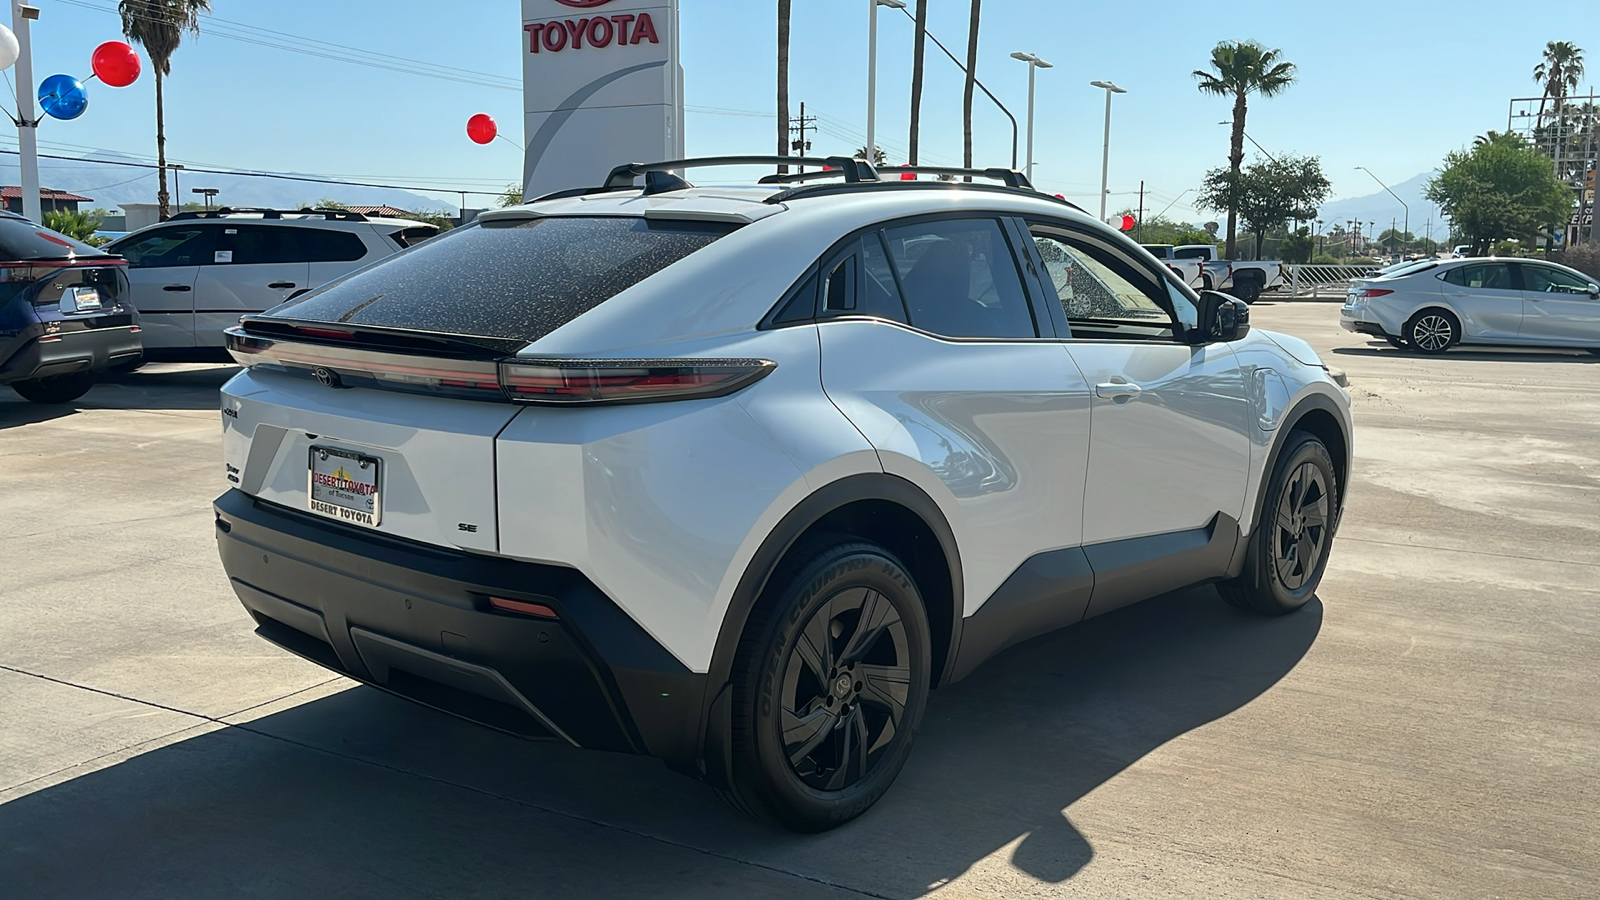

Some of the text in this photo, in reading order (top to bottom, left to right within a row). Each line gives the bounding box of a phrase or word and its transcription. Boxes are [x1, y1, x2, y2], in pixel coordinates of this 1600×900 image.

[524, 13, 659, 53] TOYOTA
[314, 472, 376, 496] DESERT TOYOTA
[335, 490, 355, 501] Tucson
[311, 500, 373, 525] DESERT TOYOTA
[458, 522, 478, 533] SE
[789, 557, 873, 626] COUNTRY
